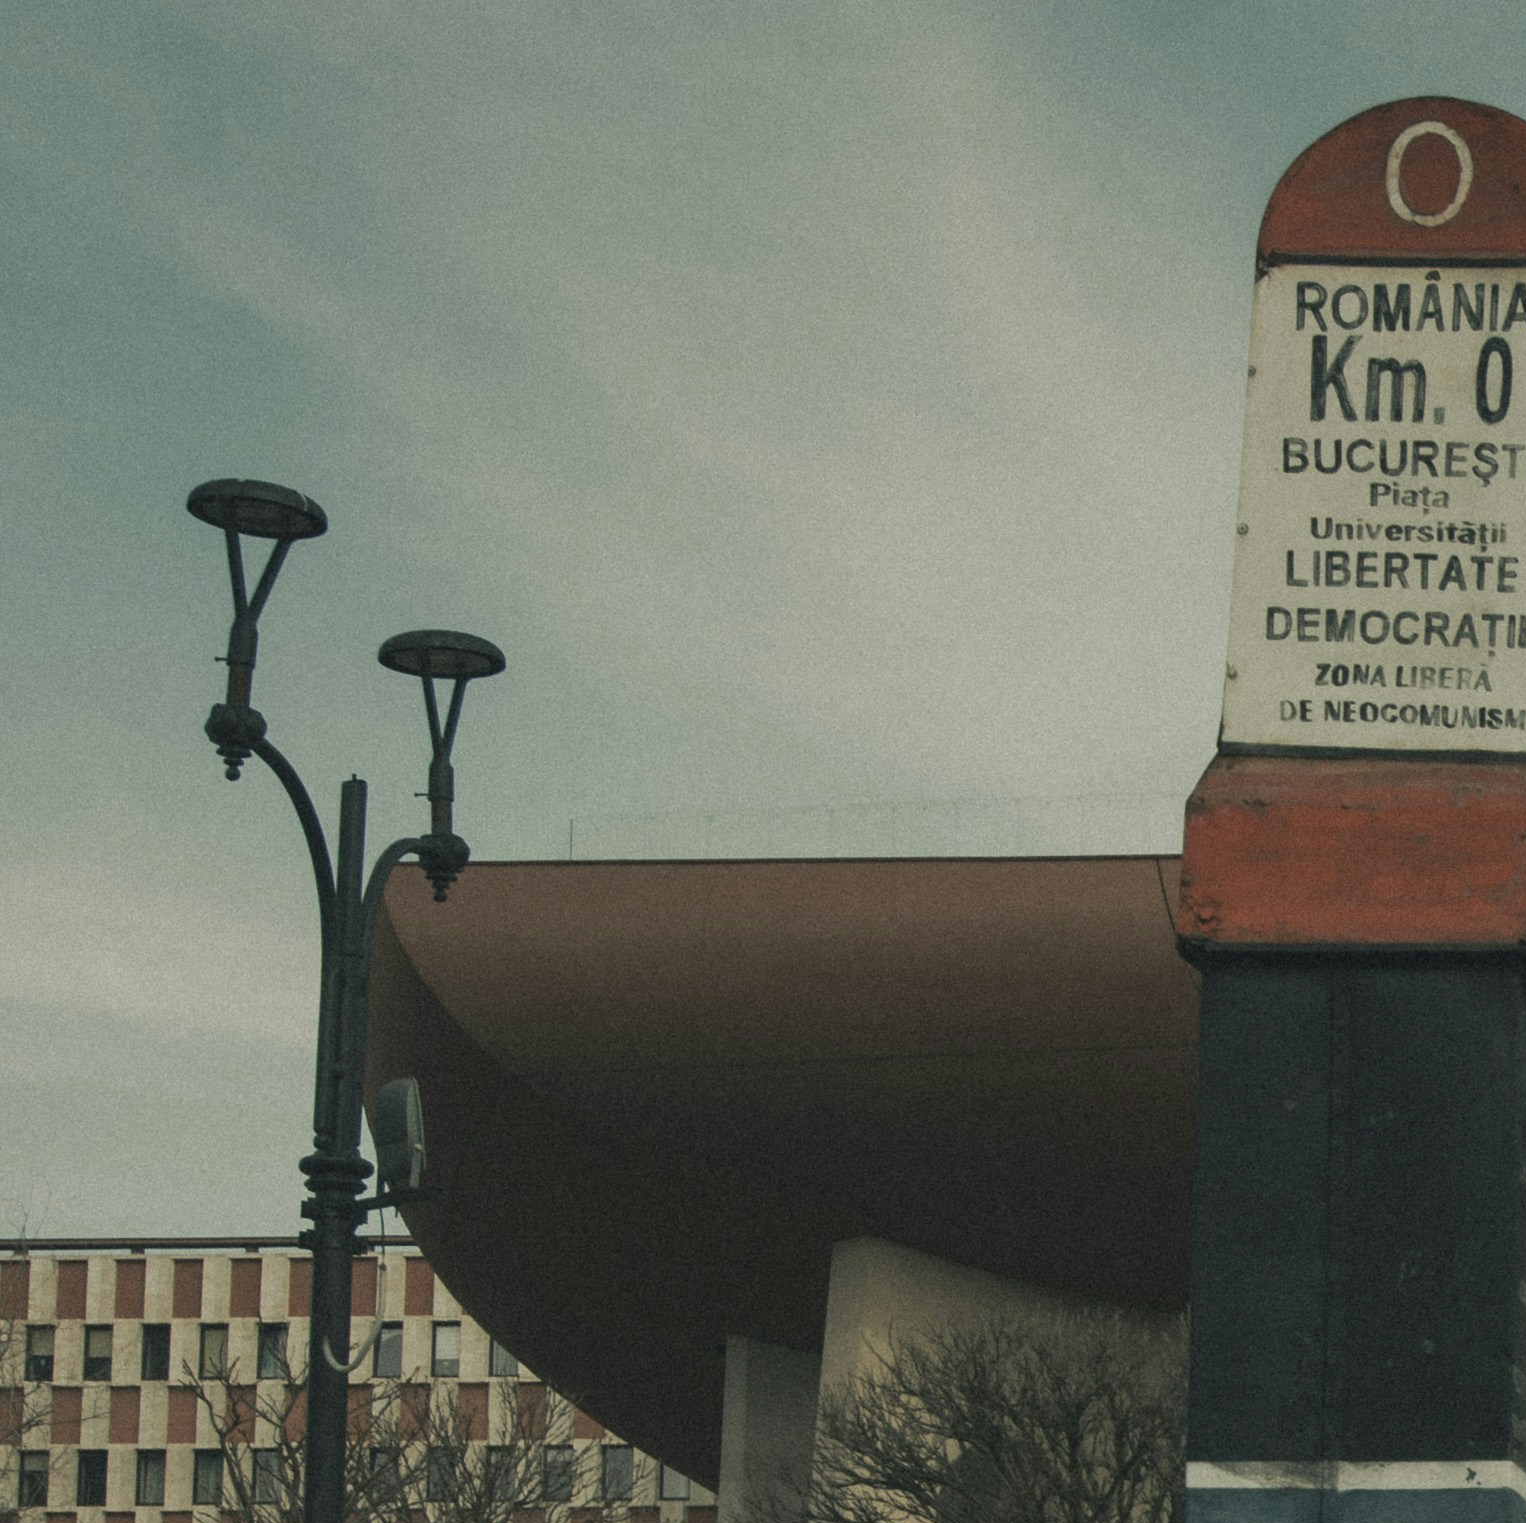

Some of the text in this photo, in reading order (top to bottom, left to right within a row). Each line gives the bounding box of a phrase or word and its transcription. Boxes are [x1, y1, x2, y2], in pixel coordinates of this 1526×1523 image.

[1310, 335, 1513, 425] Km. 0
[1369, 482, 1450, 514] Piața
[1310, 517, 1506, 552] Universității
[1286, 551, 1518, 593] LIBERTATE
[1315, 663, 1386, 688] ZONA
[1280, 700, 1526, 731] DE NEOCOMUNISM
